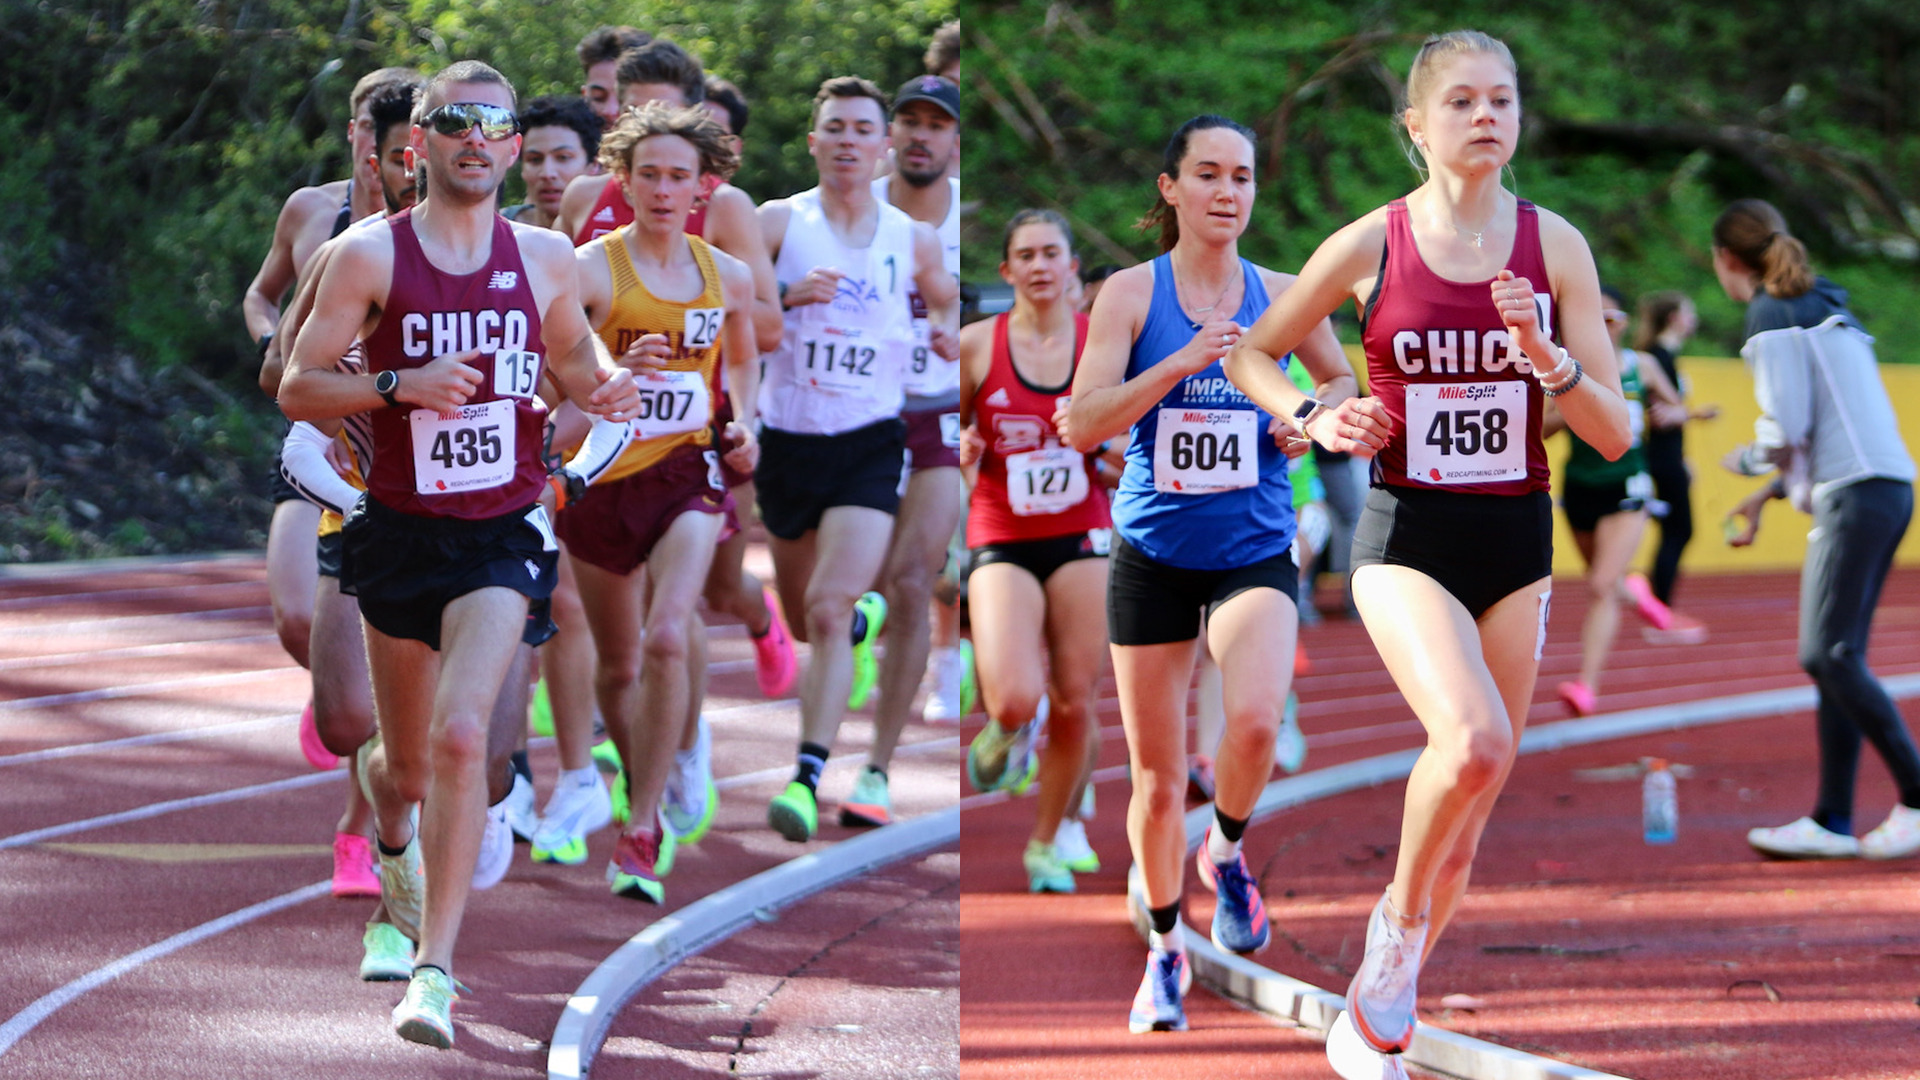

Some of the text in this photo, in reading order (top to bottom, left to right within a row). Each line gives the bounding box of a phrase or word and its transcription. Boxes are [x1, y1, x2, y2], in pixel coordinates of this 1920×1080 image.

[402, 310, 527, 357] CHICO
[692, 311, 719, 344] 26
[504, 352, 535, 394] 15
[803, 340, 876, 376] 1142
[637, 390, 694, 421] 507
[1182, 395, 1226, 404] RACING
[1437, 384, 1497, 401] MileSplit
[1182, 412, 1231, 426] MileSplit
[1425, 408, 1509, 456] 458
[430, 424, 502, 469] 435
[1171, 431, 1241, 471] 604
[1025, 467, 1071, 496] 127
[1446, 468, 1508, 479] REDCAPTIMING.COM
